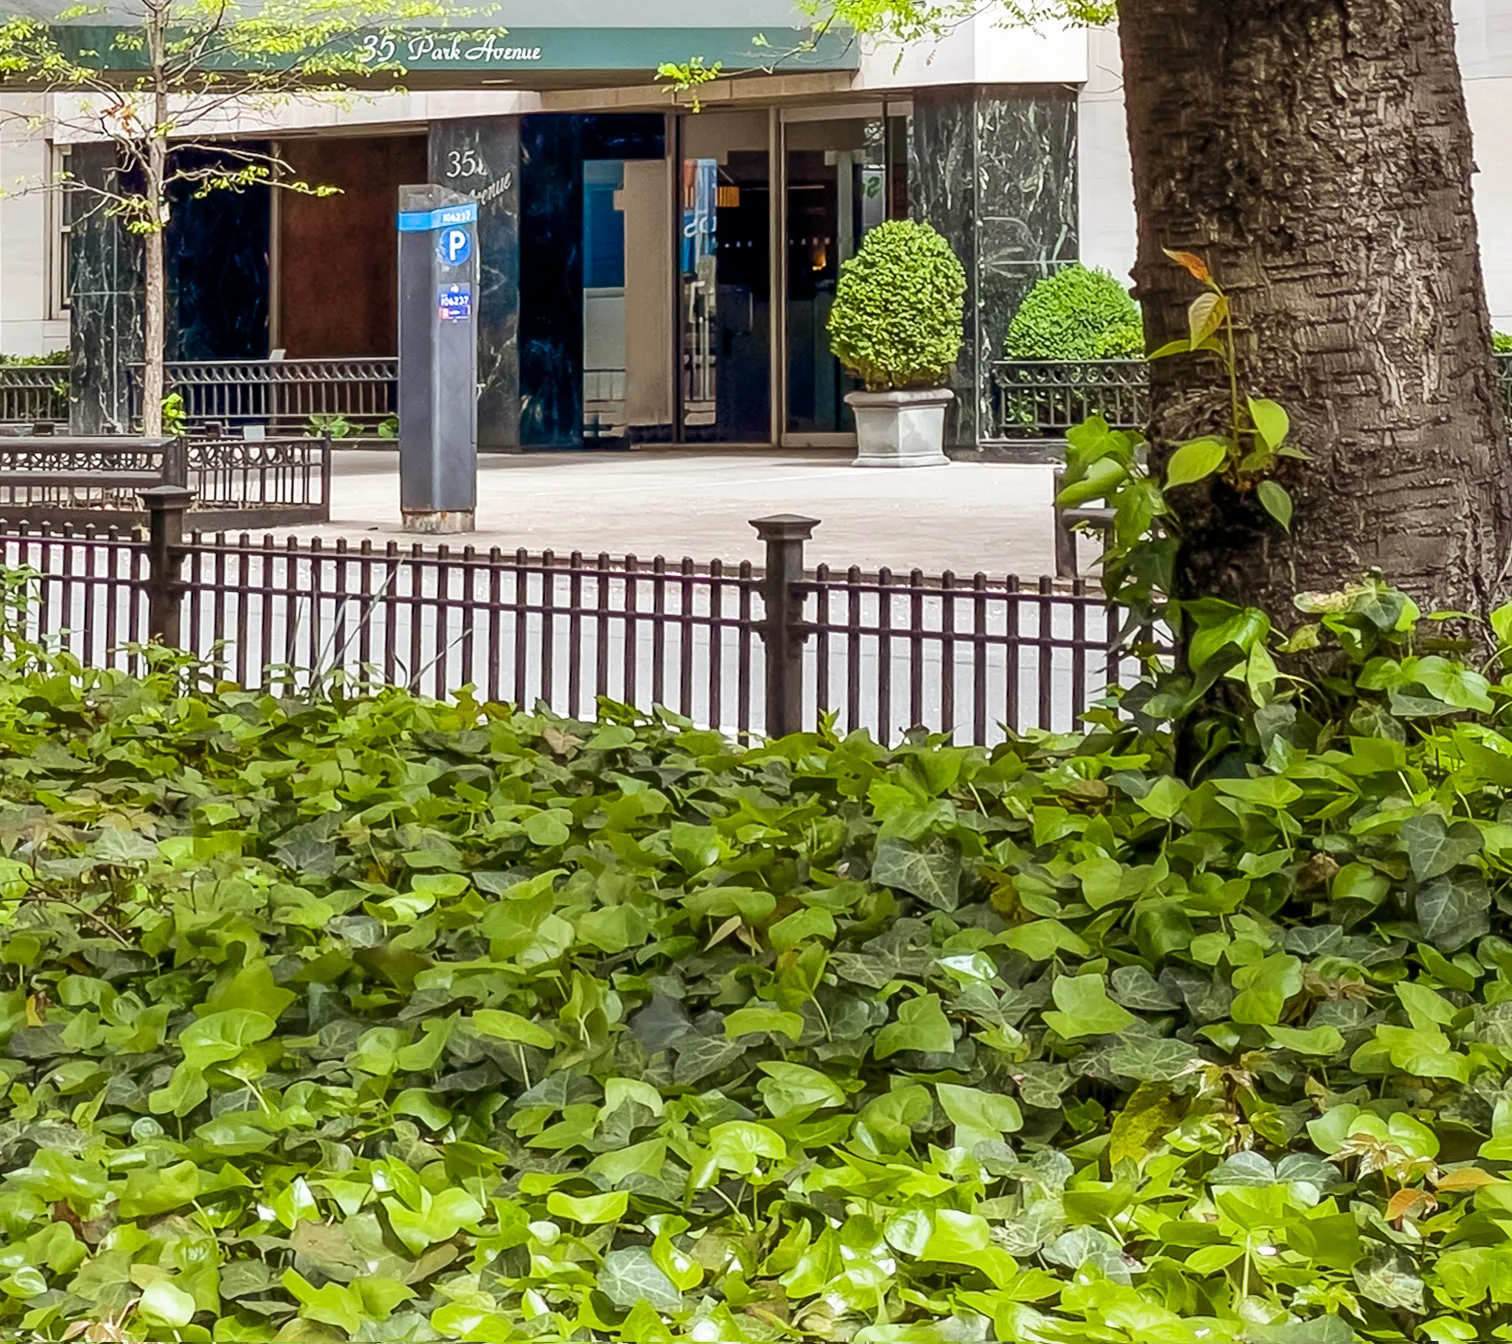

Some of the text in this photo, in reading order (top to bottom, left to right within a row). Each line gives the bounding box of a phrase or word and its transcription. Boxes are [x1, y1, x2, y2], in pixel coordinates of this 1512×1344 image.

[359, 34, 542, 63] 35 Park Avenue
[446, 149, 477, 178] 35
[449, 230, 466, 261] P
